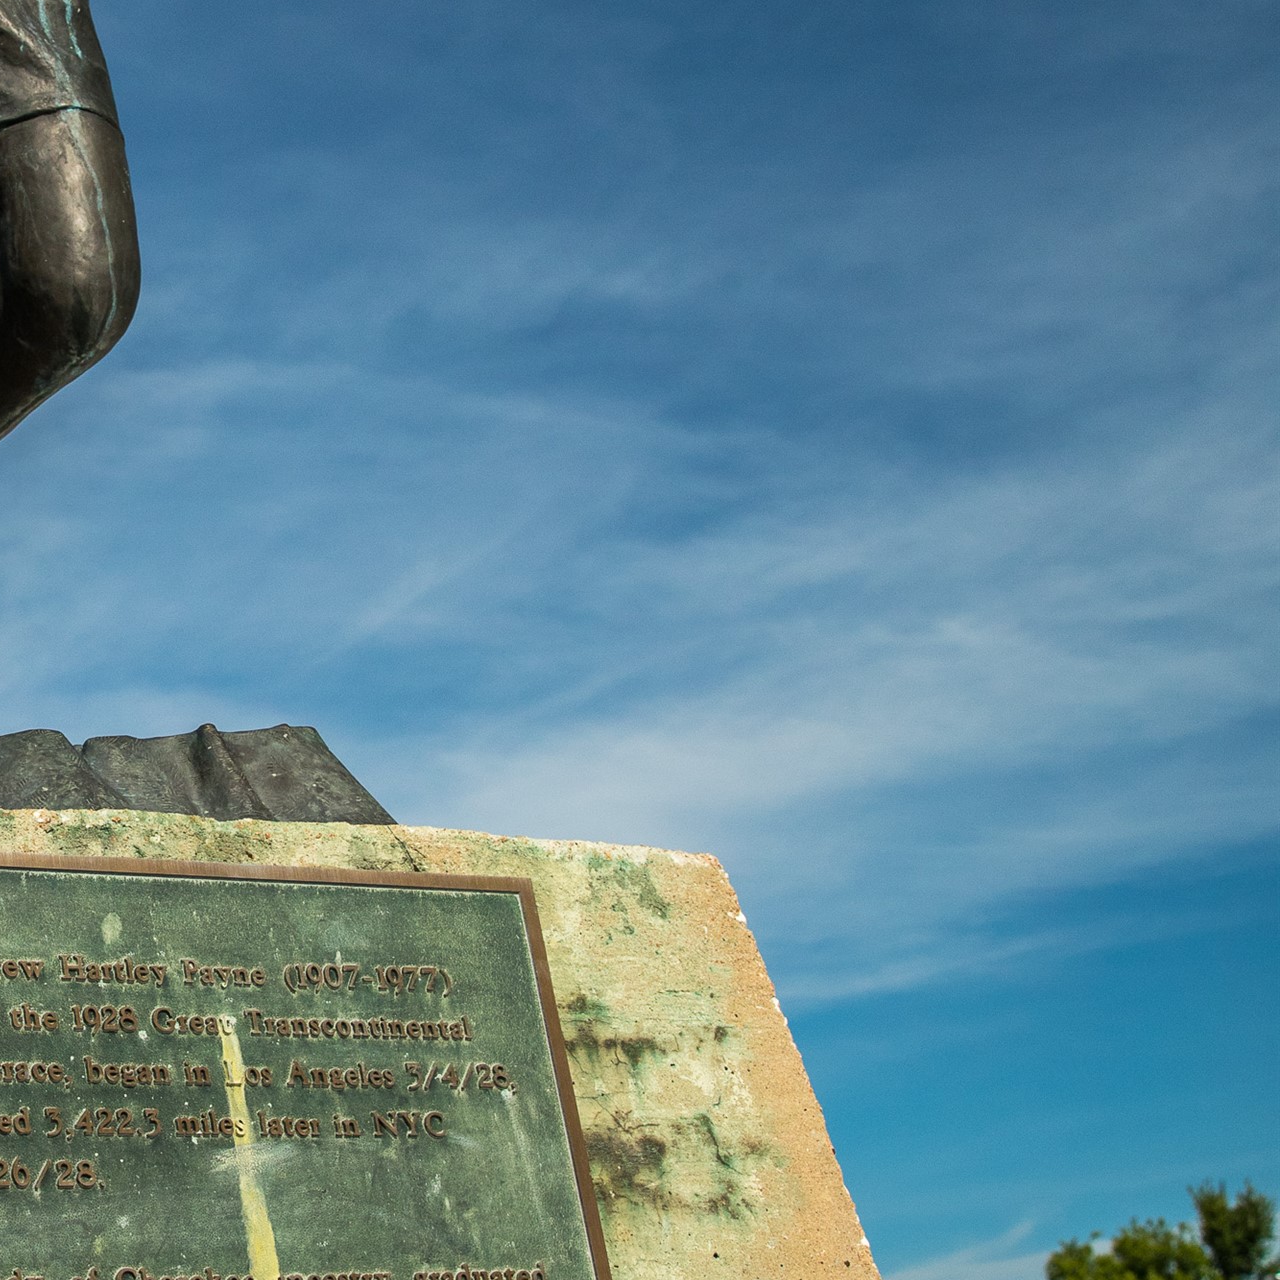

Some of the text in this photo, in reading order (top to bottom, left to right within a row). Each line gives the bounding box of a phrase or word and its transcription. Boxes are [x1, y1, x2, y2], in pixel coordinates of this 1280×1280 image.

[59, 954, 168, 986] Hartley
[181, 958, 266, 990] Payne
[284, 963, 452, 998] (1907-1977)
[10, 1002, 59, 1031] the
[72, 1005, 138, 1036] 1928
[152, 1007, 236, 1034] Great
[244, 1008, 472, 1040] Transcontinental
[84, 1056, 170, 1088] began
[184, 1062, 211, 1086] in
[223, 1060, 272, 1087] Los
[286, 1060, 395, 1092] Angeles
[405, 1062, 516, 1095] 3/4/28,
[44, 1106, 162, 1141] 3,422.3
[174, 1110, 246, 1138] miles
[257, 1111, 320, 1138] later
[333, 1114, 360, 1138] in
[372, 1111, 448, 1139] NYC
